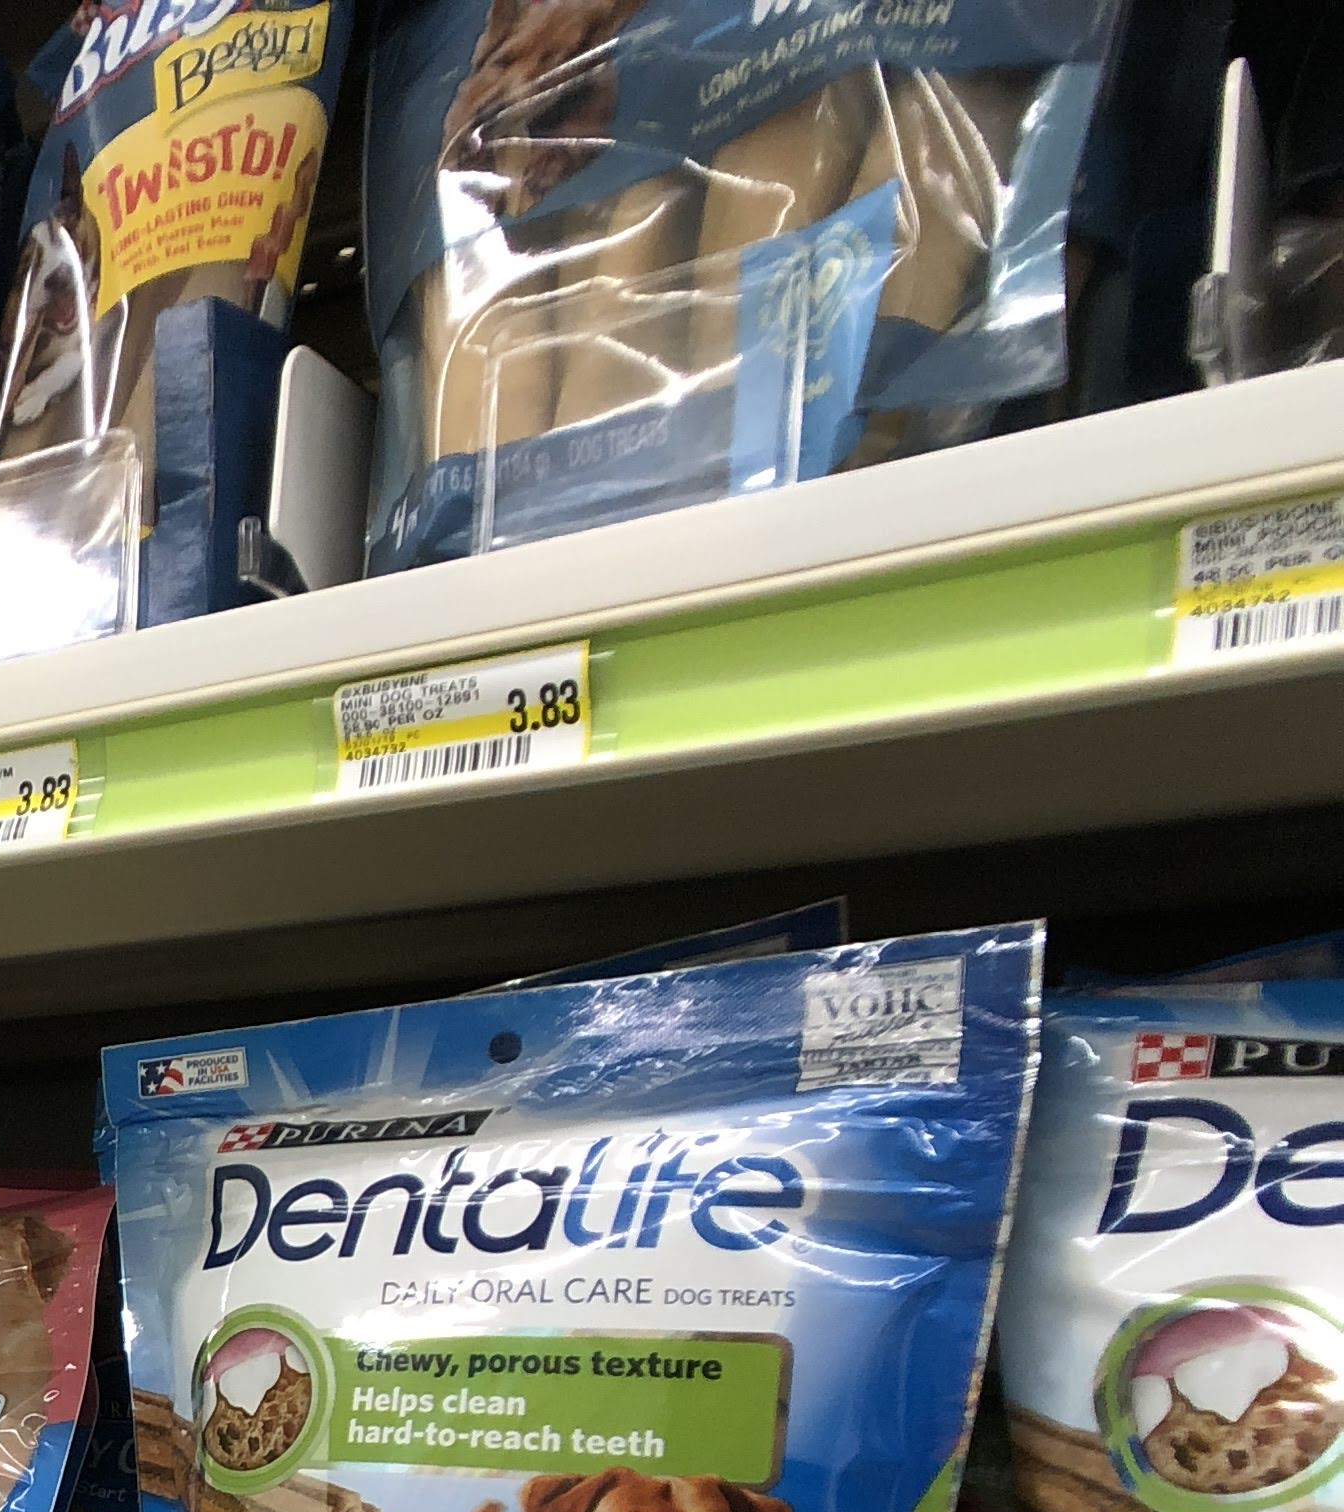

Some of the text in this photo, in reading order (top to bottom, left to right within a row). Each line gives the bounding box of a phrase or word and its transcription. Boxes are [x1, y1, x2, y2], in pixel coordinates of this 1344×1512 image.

[98, 112, 297, 232] TWIST'D!
[507, 678, 581, 734] 3.83
[15, 773, 72, 817] 3.83
[270, 1112, 473, 1147] PURINA
[470, 1277, 555, 1305] ORAL
[563, 1276, 654, 1306] CARE
[662, 1288, 714, 1306] DOG
[717, 1289, 797, 1308] TREATS
[356, 1350, 724, 1381] Chewy, porous texture
[351, 1386, 526, 1416] Helps clean
[346, 1419, 666, 1460] hard-to-reach teeth
